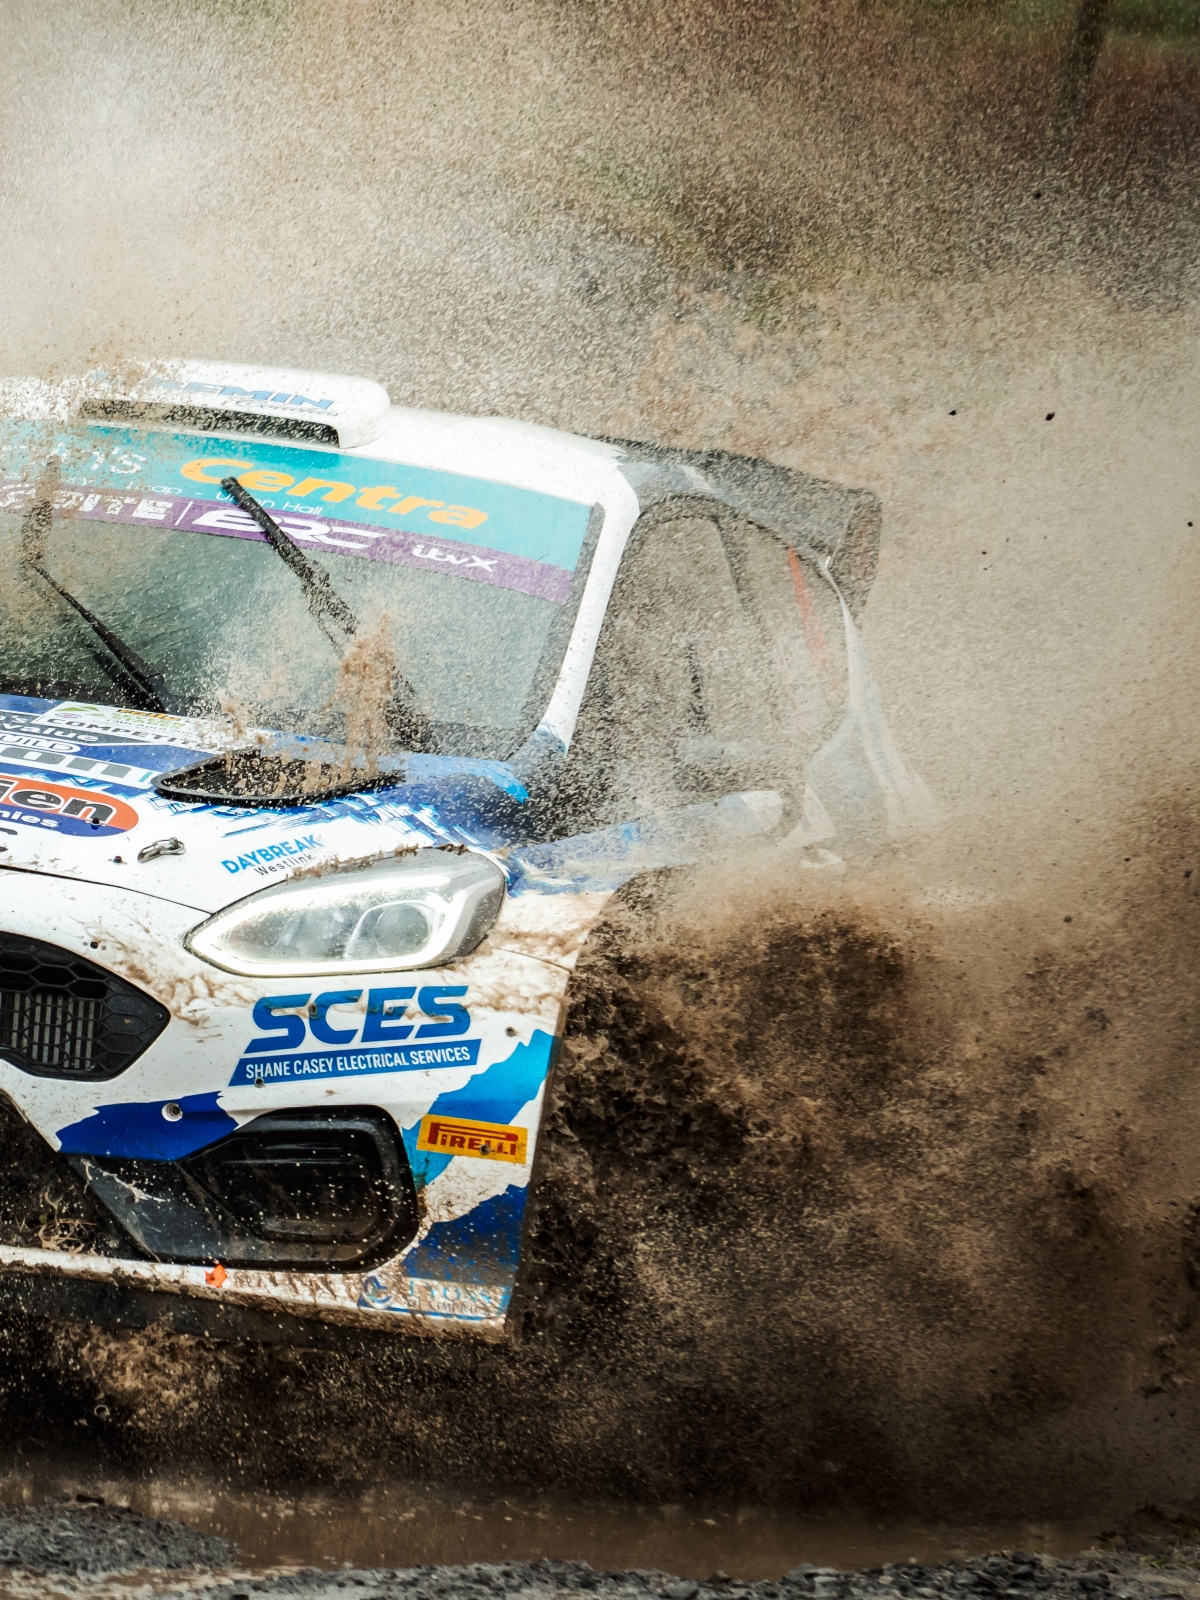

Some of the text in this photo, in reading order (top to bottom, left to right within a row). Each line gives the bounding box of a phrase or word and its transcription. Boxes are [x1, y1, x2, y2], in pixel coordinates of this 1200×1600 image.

[180, 458, 489, 530] Centra
[282, 501, 323, 515] Hall
[220, 834, 322, 875] DAYBREAK
[253, 853, 316, 877] Westlink
[244, 985, 471, 1054] SCES
[245, 1045, 471, 1080] SHANE CASEY ELECTRICAL SERVICES
[427, 1122, 519, 1155] PIRELLI
